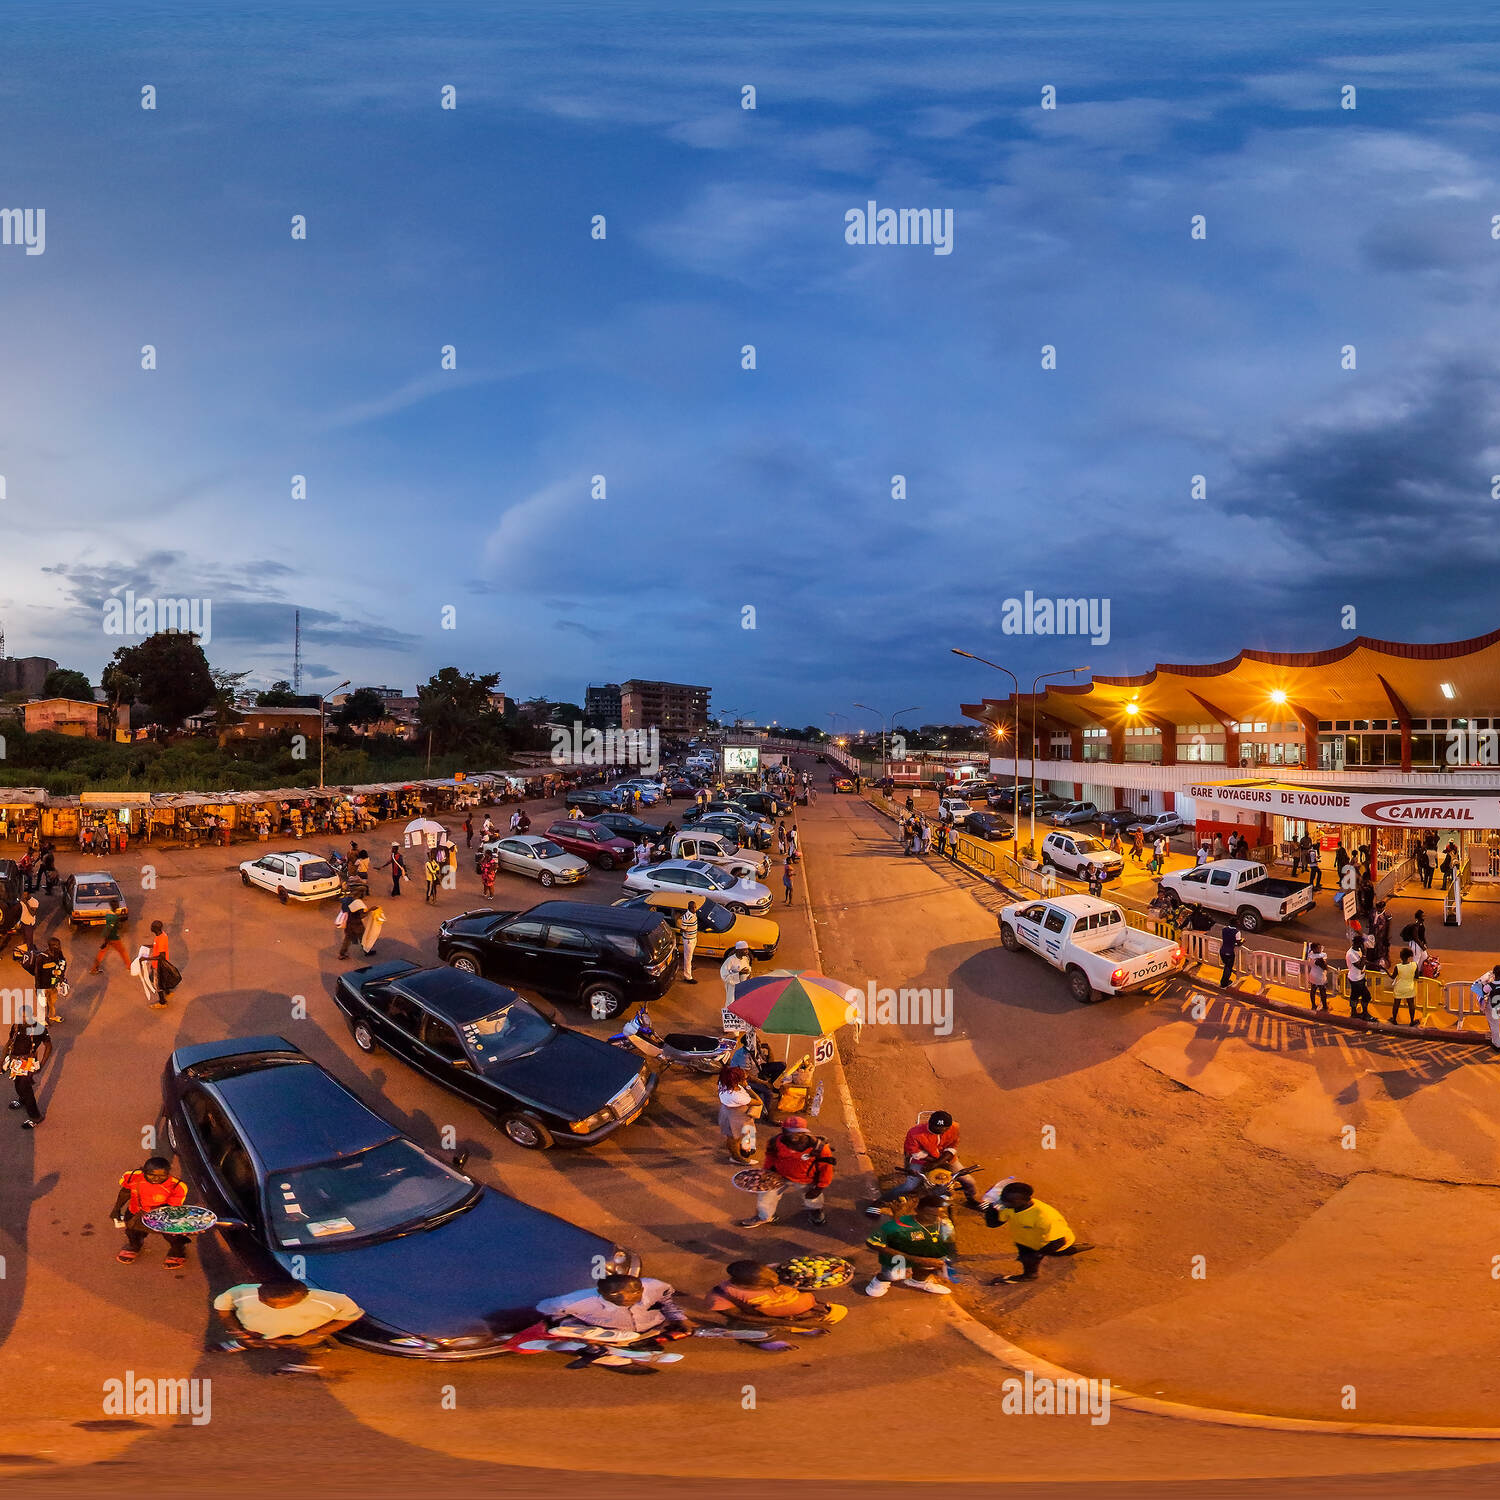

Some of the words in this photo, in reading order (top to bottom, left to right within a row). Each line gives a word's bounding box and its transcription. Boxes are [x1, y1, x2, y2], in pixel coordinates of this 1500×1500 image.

[1190, 787, 1213, 798] GARE
[1217, 788, 1272, 803] VOYAGEURS
[1280, 792, 1295, 804] DE
[1298, 794, 1351, 808] YAOUNDE
[1388, 806, 1475, 820] CAMRAIL
[1132, 960, 1168, 979] TOYOTA
[816, 1042, 833, 1061] 50
